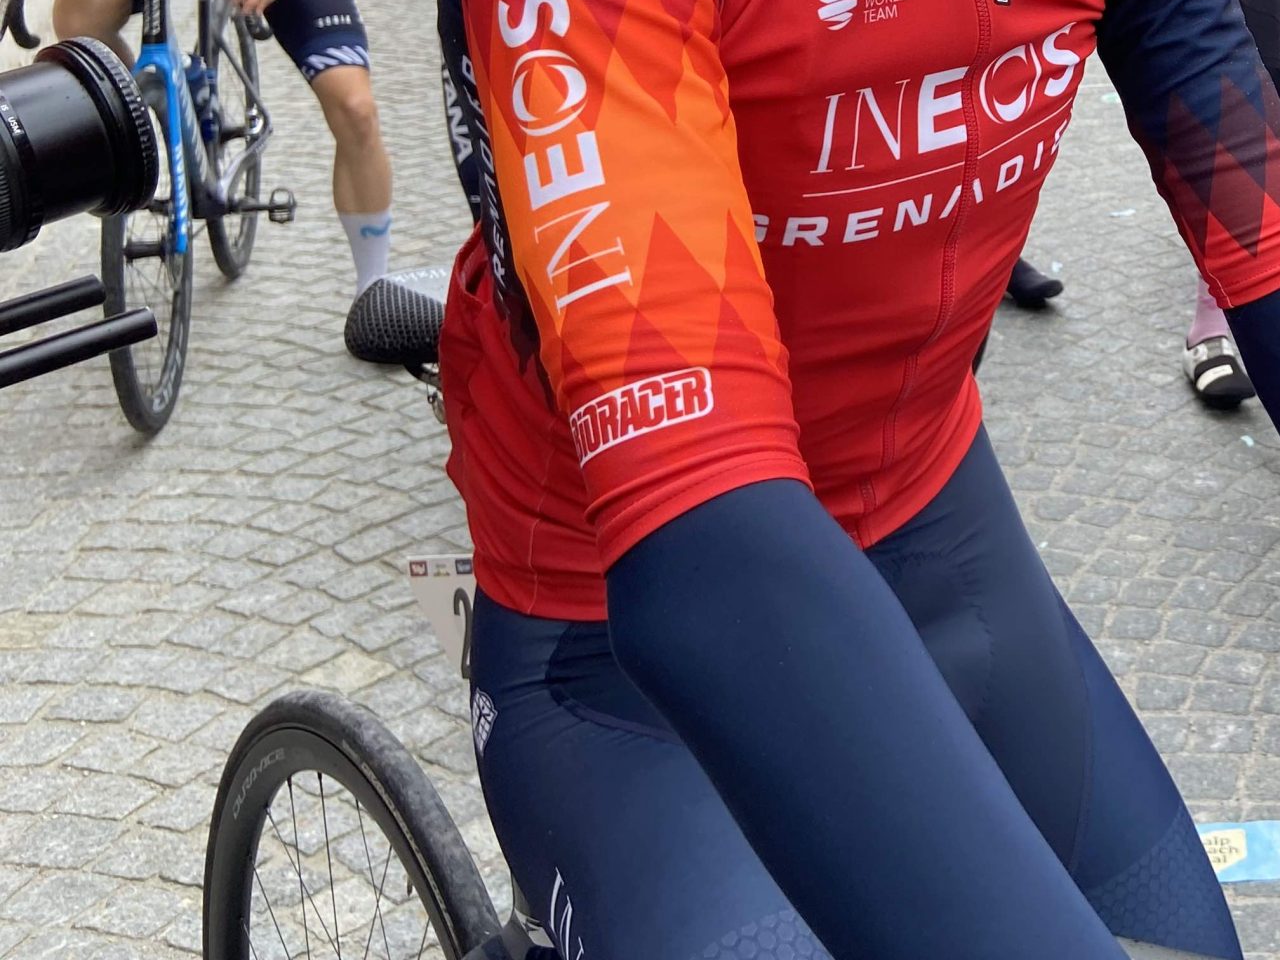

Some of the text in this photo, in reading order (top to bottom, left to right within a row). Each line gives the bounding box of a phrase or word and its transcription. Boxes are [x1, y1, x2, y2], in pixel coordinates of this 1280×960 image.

[864, 6, 898, 23] TEAM
[810, 21, 1081, 174] INEOS
[571, 371, 709, 460] BIORACER
[1207, 845, 1240, 854] ach
